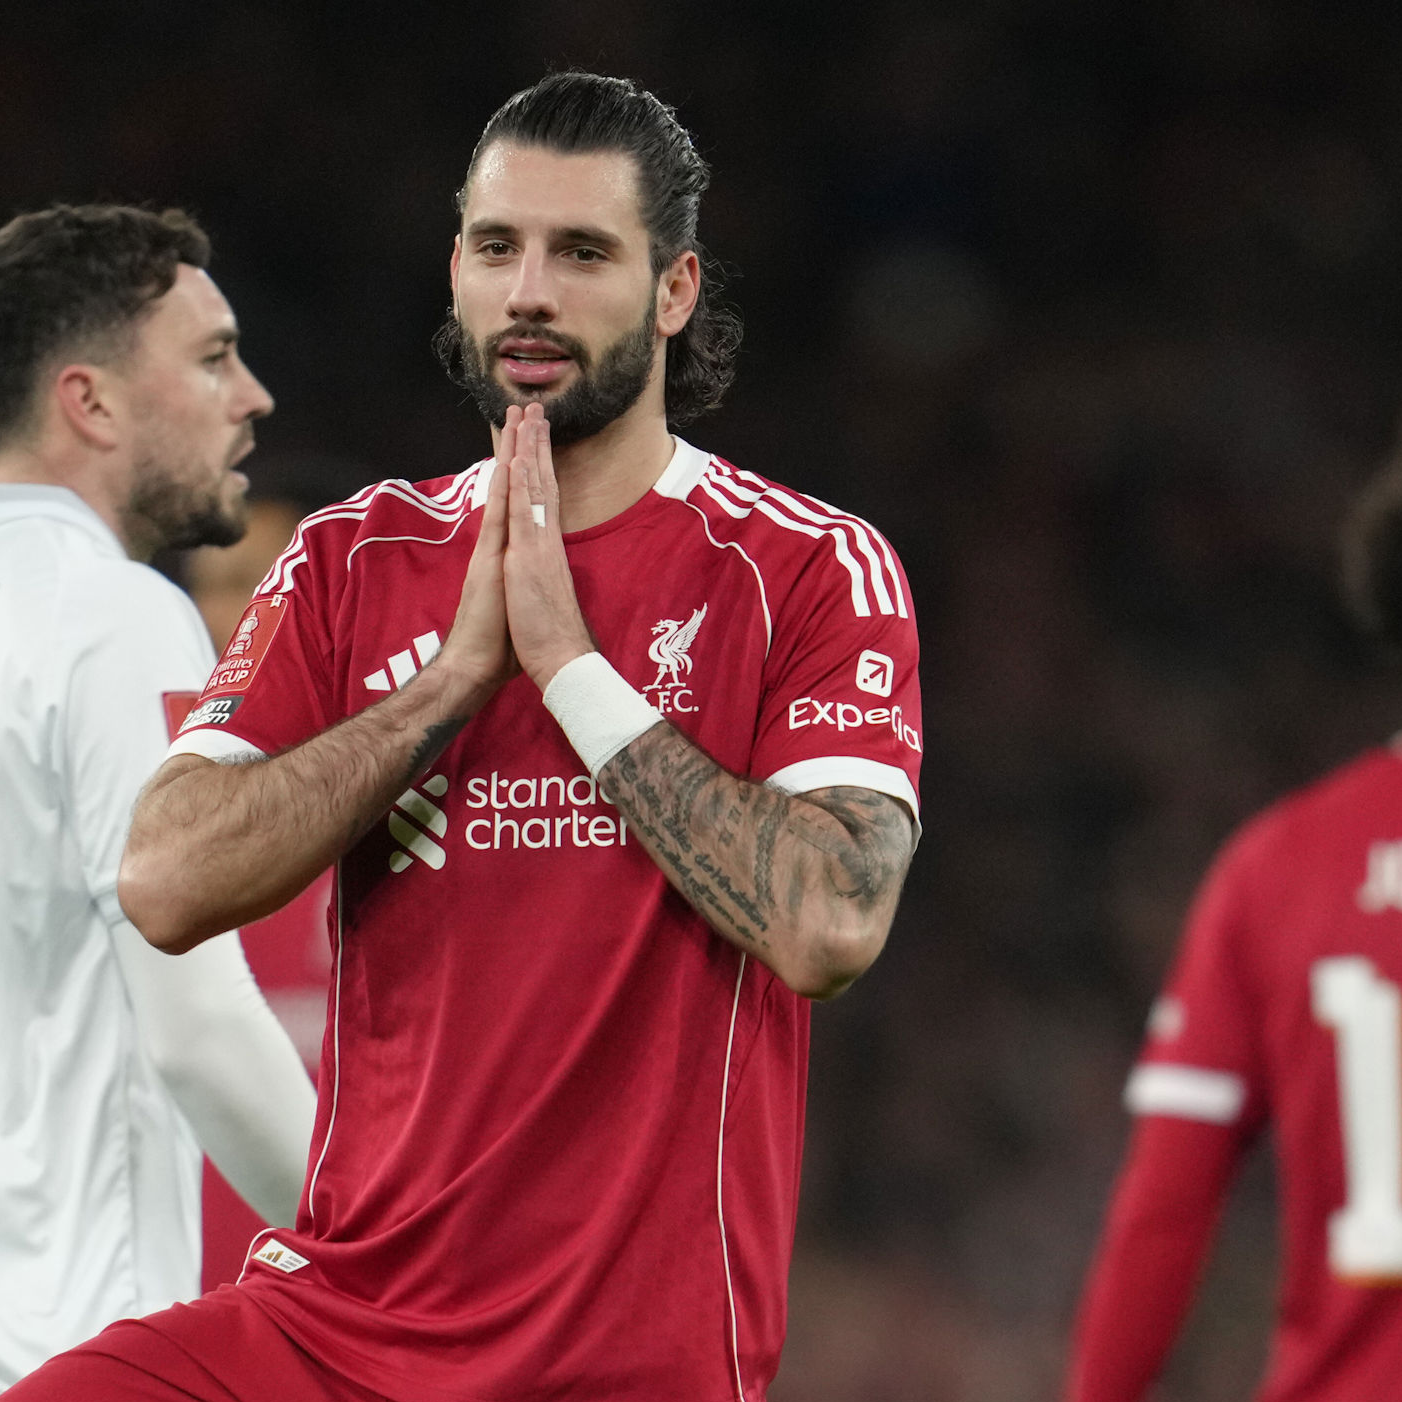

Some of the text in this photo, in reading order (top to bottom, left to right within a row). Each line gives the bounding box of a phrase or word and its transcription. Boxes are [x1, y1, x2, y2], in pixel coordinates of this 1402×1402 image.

[218, 669, 250, 686] CUP
[466, 770, 616, 809] stand
[465, 808, 628, 850] charter
